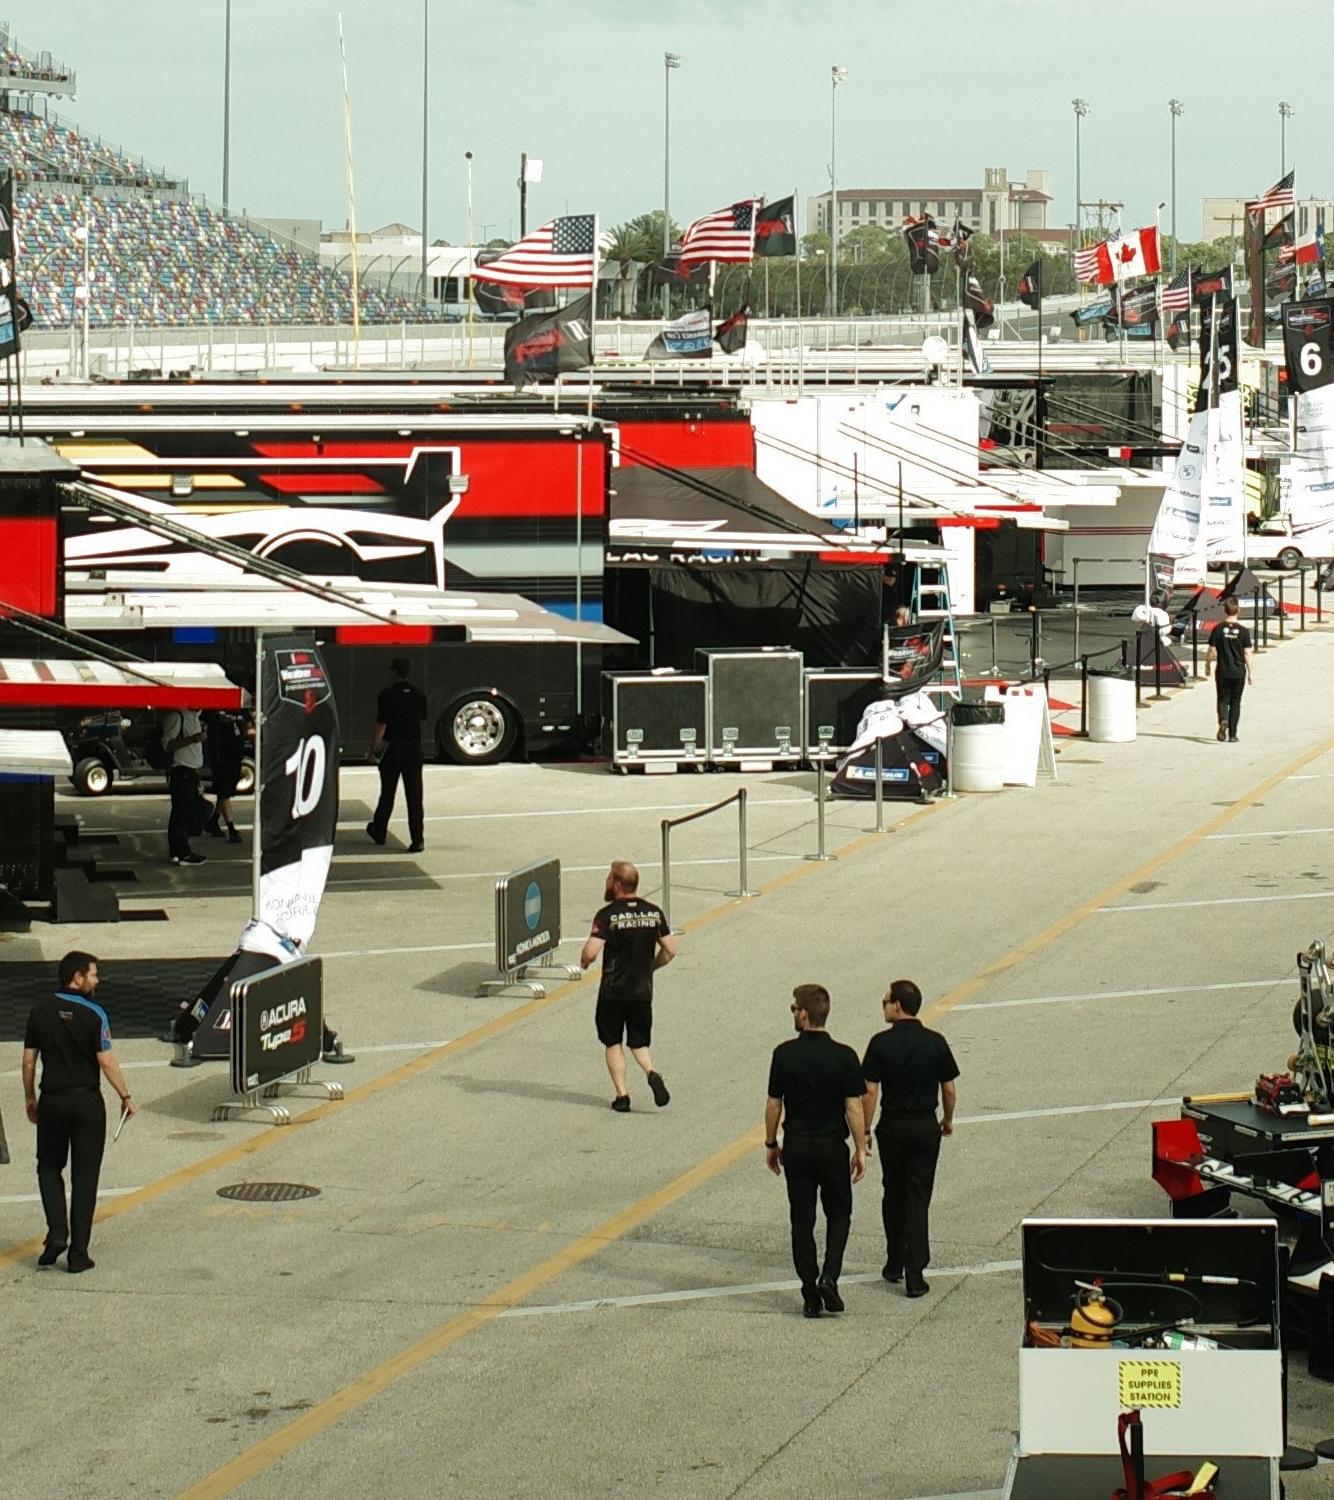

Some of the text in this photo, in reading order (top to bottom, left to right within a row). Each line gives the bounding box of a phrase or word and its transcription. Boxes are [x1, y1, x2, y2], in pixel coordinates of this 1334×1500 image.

[1300, 342, 1322, 376] 6
[286, 734, 326, 820] 10
[610, 911, 660, 922] CADILLAC
[618, 920, 656, 930] RACING
[269, 996, 307, 1029] ACURA
[1141, 1369, 1158, 1377] PPE
[1128, 1381, 1172, 1389] SUPPLIES
[1130, 1393, 1171, 1401] STATION
